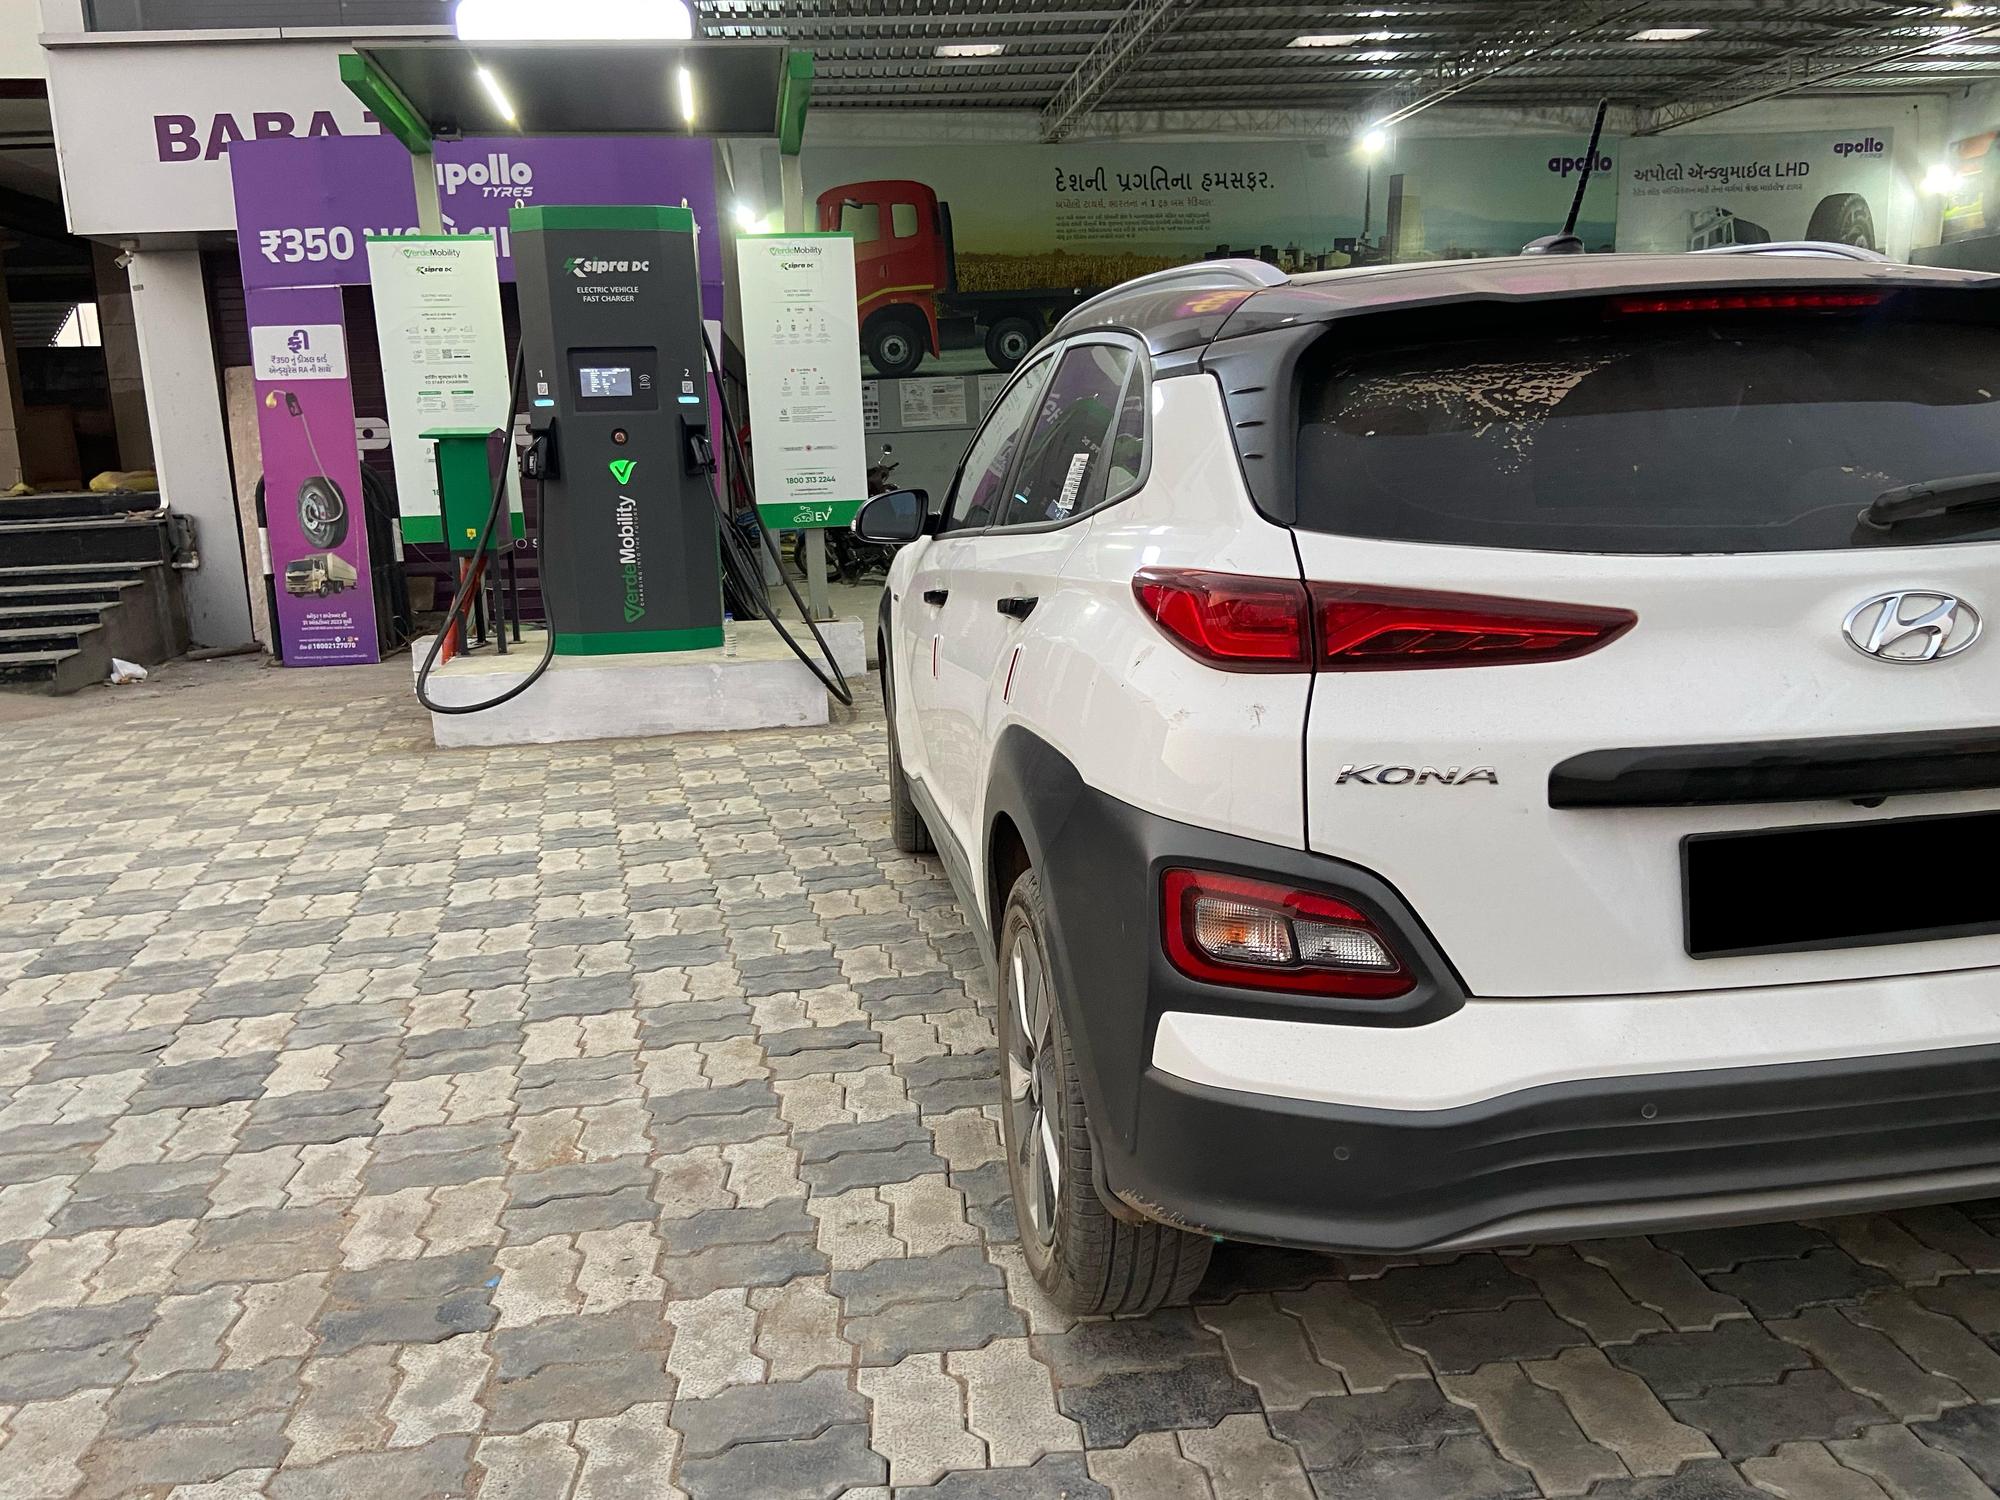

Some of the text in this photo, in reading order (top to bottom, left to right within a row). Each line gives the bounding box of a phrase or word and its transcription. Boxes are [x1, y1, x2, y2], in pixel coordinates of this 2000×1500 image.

[1833, 137, 1884, 157] apollo
[1548, 150, 1612, 178] apolo
[1634, 162, 1684, 182] અપોલો
[1775, 161, 1810, 178] LHD
[1055, 166, 1108, 192] દેશની
[1116, 165, 1193, 192] પ્રગતિના
[482, 186, 534, 198] TYRES
[259, 226, 354, 263] ₹350
[403, 248, 460, 258] VerdeMobility
[632, 260, 650, 272] DC
[576, 286, 609, 294] ELECTRIC
[271, 355, 290, 364] ₹350
[538, 369, 544, 378] 1
[684, 369, 690, 377] 2
[786, 475, 836, 485] 1800 313 2244
[815, 511, 831, 522] EV
[616, 495, 646, 624] VerdeMobility
[1335, 763, 1500, 786] KONA
